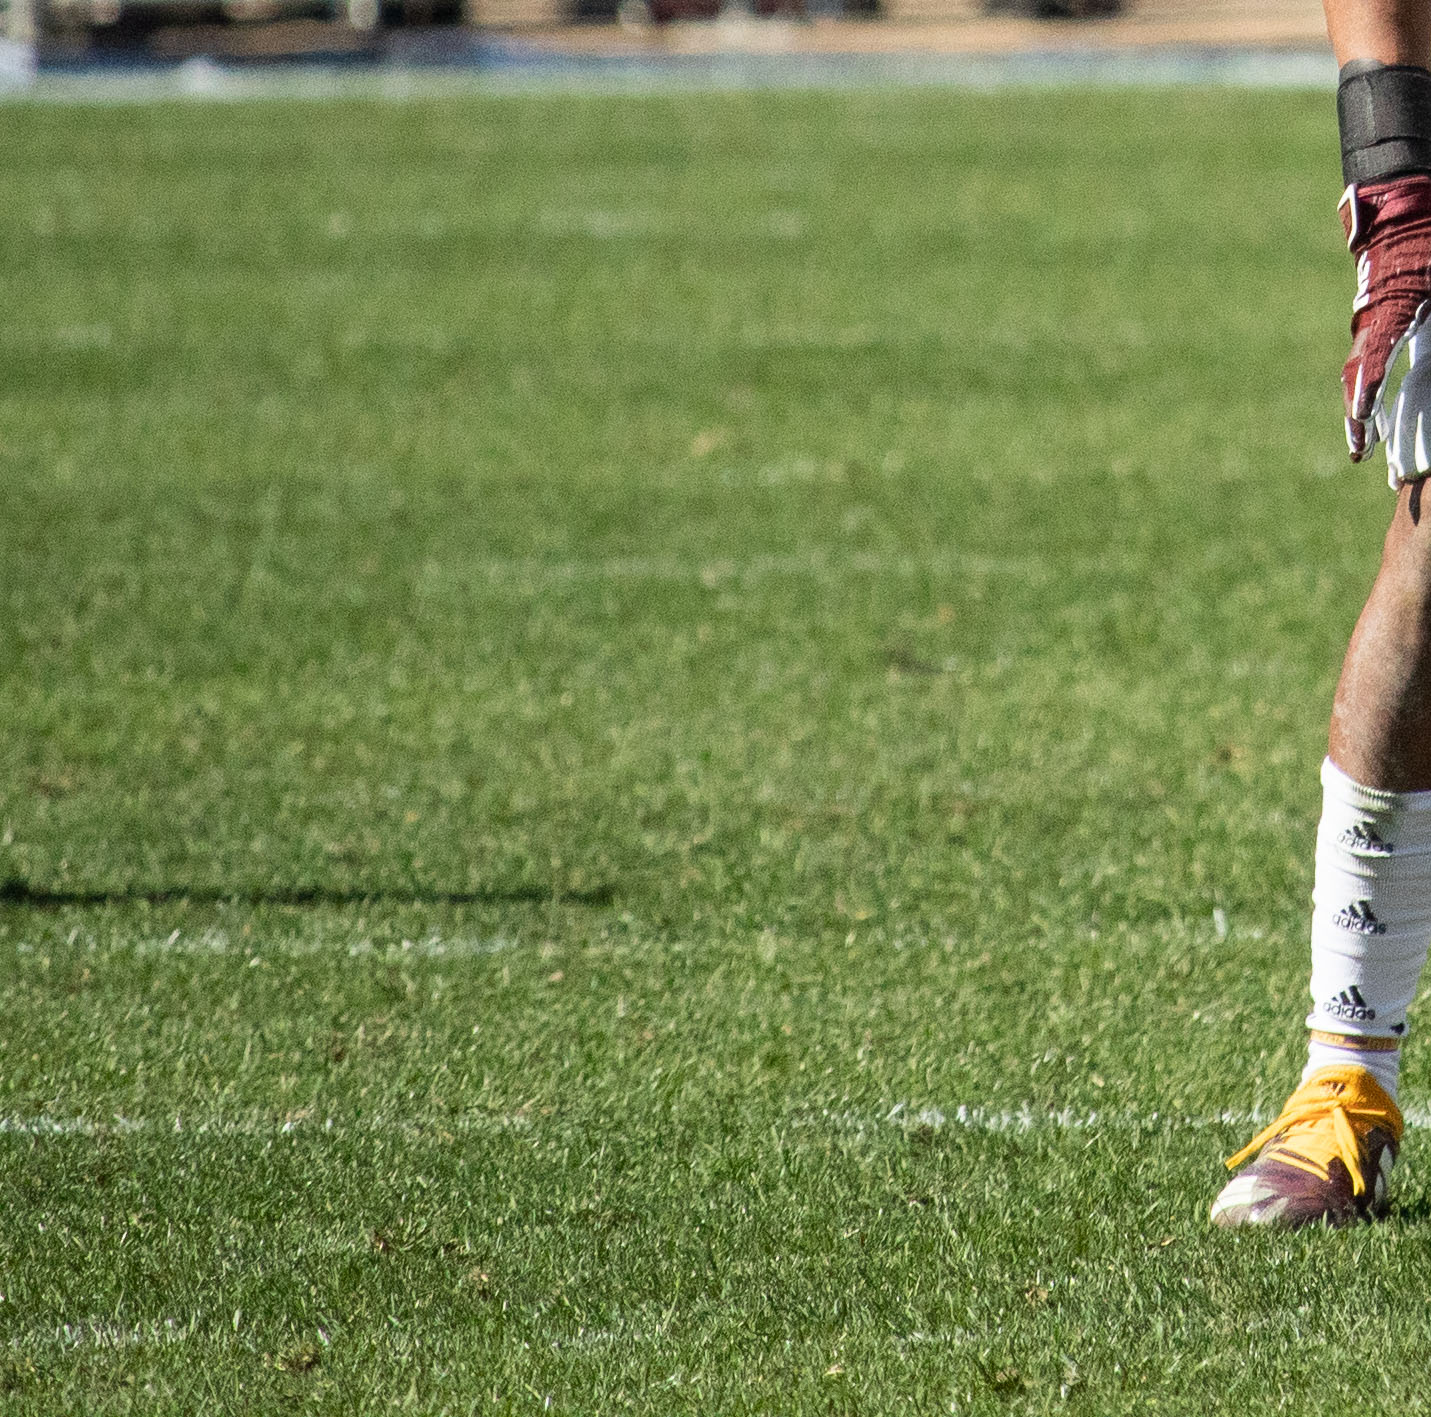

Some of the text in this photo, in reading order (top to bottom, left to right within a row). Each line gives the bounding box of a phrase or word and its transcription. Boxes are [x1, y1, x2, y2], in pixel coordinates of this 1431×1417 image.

[1337, 833, 1393, 854] adidas
[1332, 912, 1387, 934] adidas
[1322, 1001, 1376, 1021] adidas
